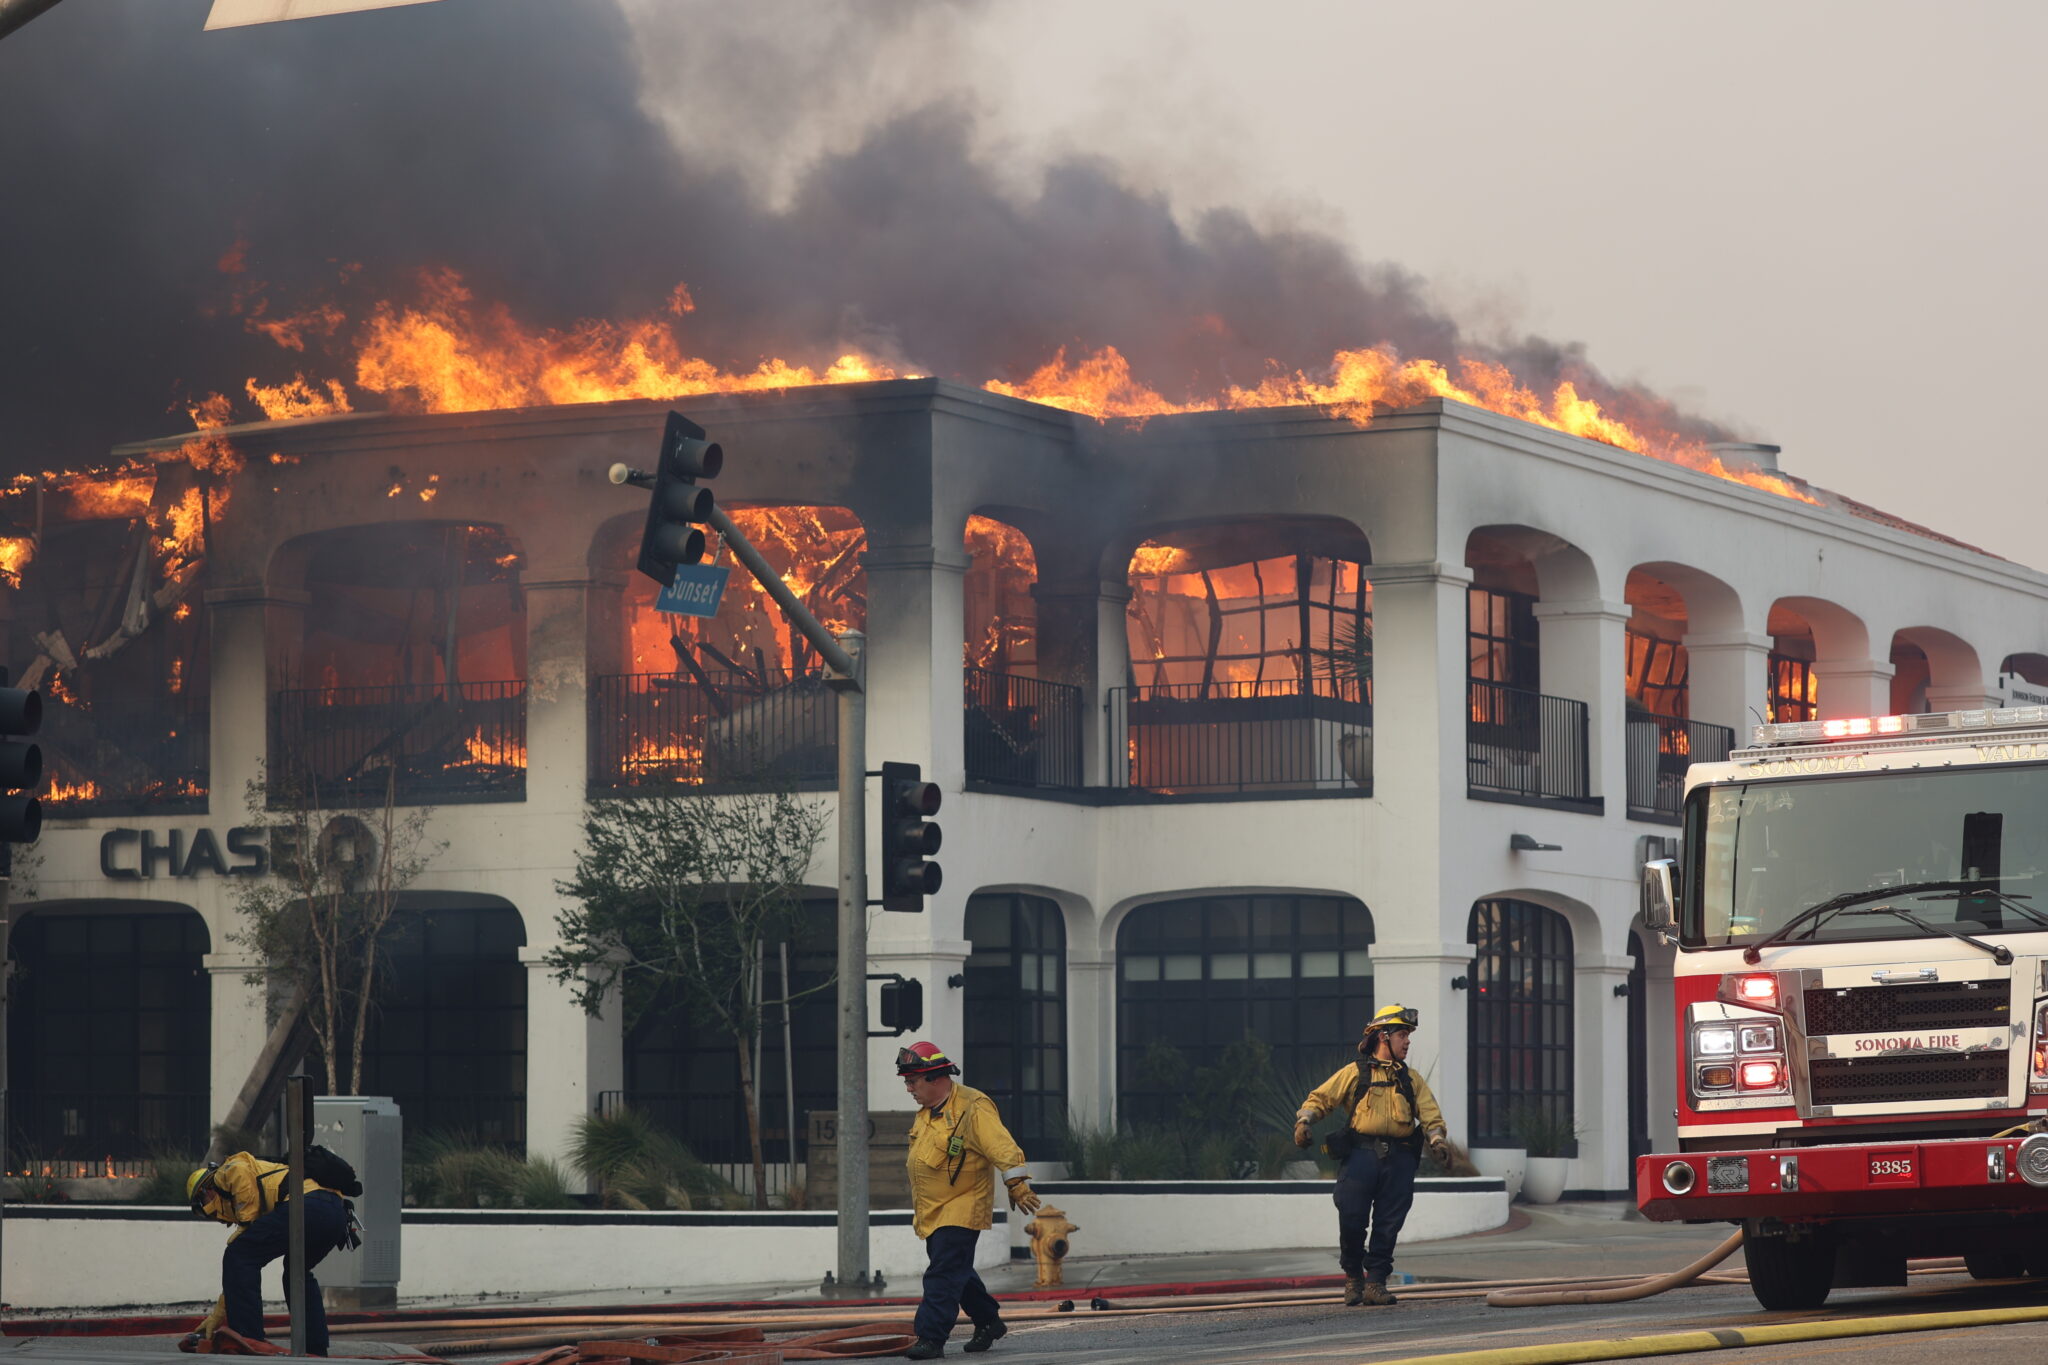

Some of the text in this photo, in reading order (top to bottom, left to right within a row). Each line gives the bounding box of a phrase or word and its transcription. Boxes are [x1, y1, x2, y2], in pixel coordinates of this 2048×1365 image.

[667, 573, 719, 605] Sunset
[1748, 755, 1866, 777] SONOMA
[100, 826, 303, 881] CHASE
[1855, 1034, 1960, 1052] SONOMA FIRE
[1871, 1160, 1912, 1175] 3385
